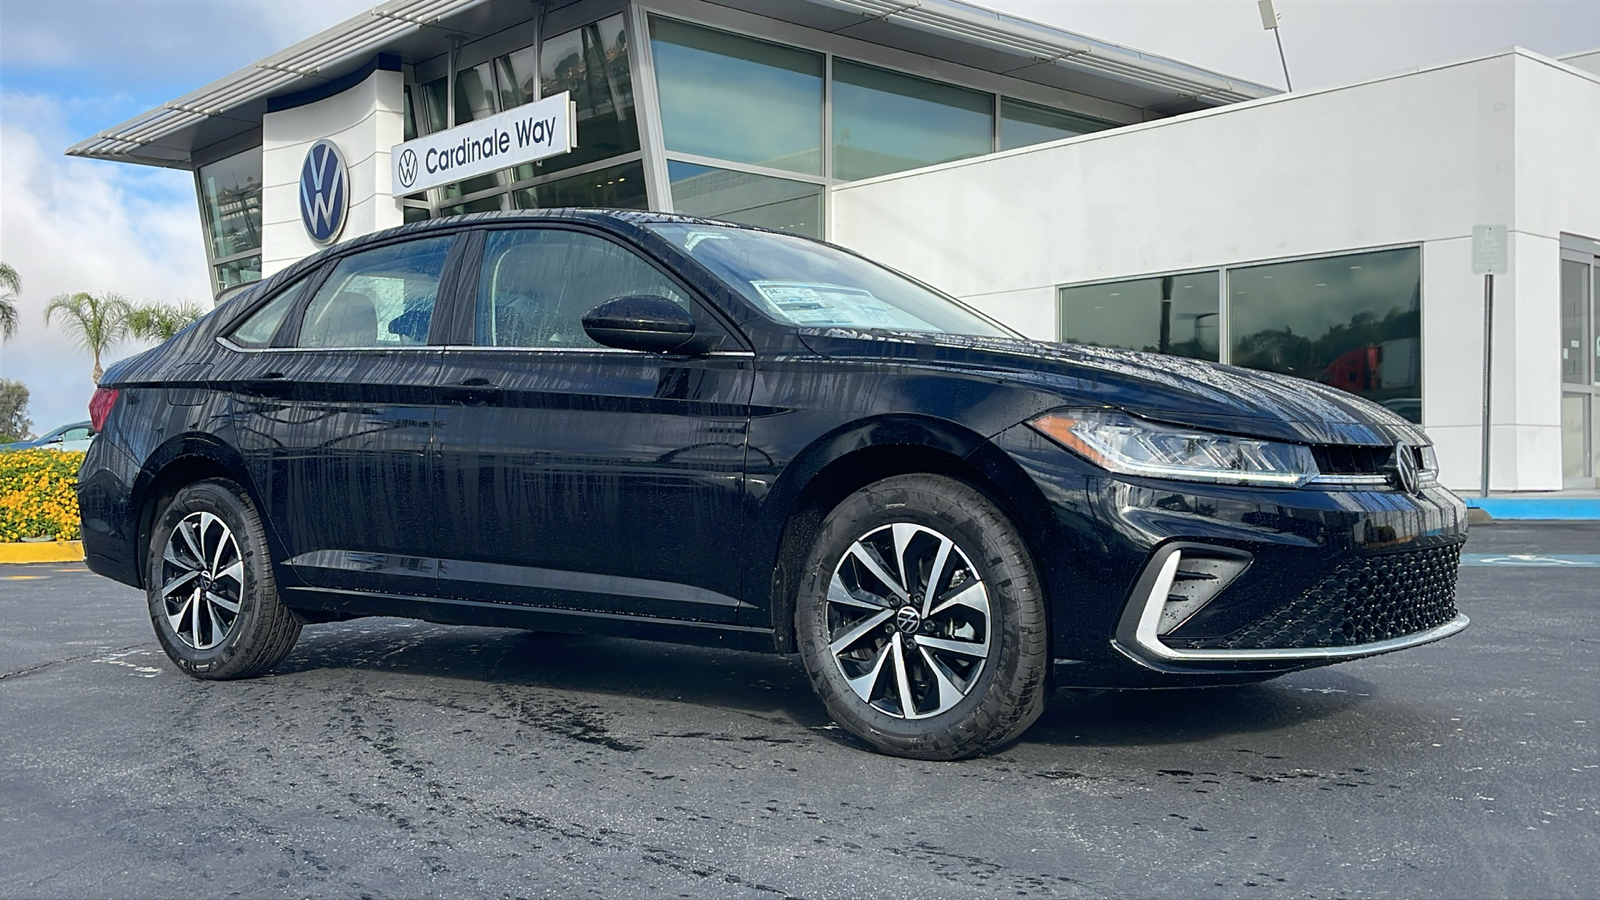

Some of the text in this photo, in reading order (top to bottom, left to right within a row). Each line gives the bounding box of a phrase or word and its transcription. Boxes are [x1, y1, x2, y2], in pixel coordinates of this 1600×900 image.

[301, 142, 346, 238] VW
[399, 117, 556, 187] VW Cardinale Way
